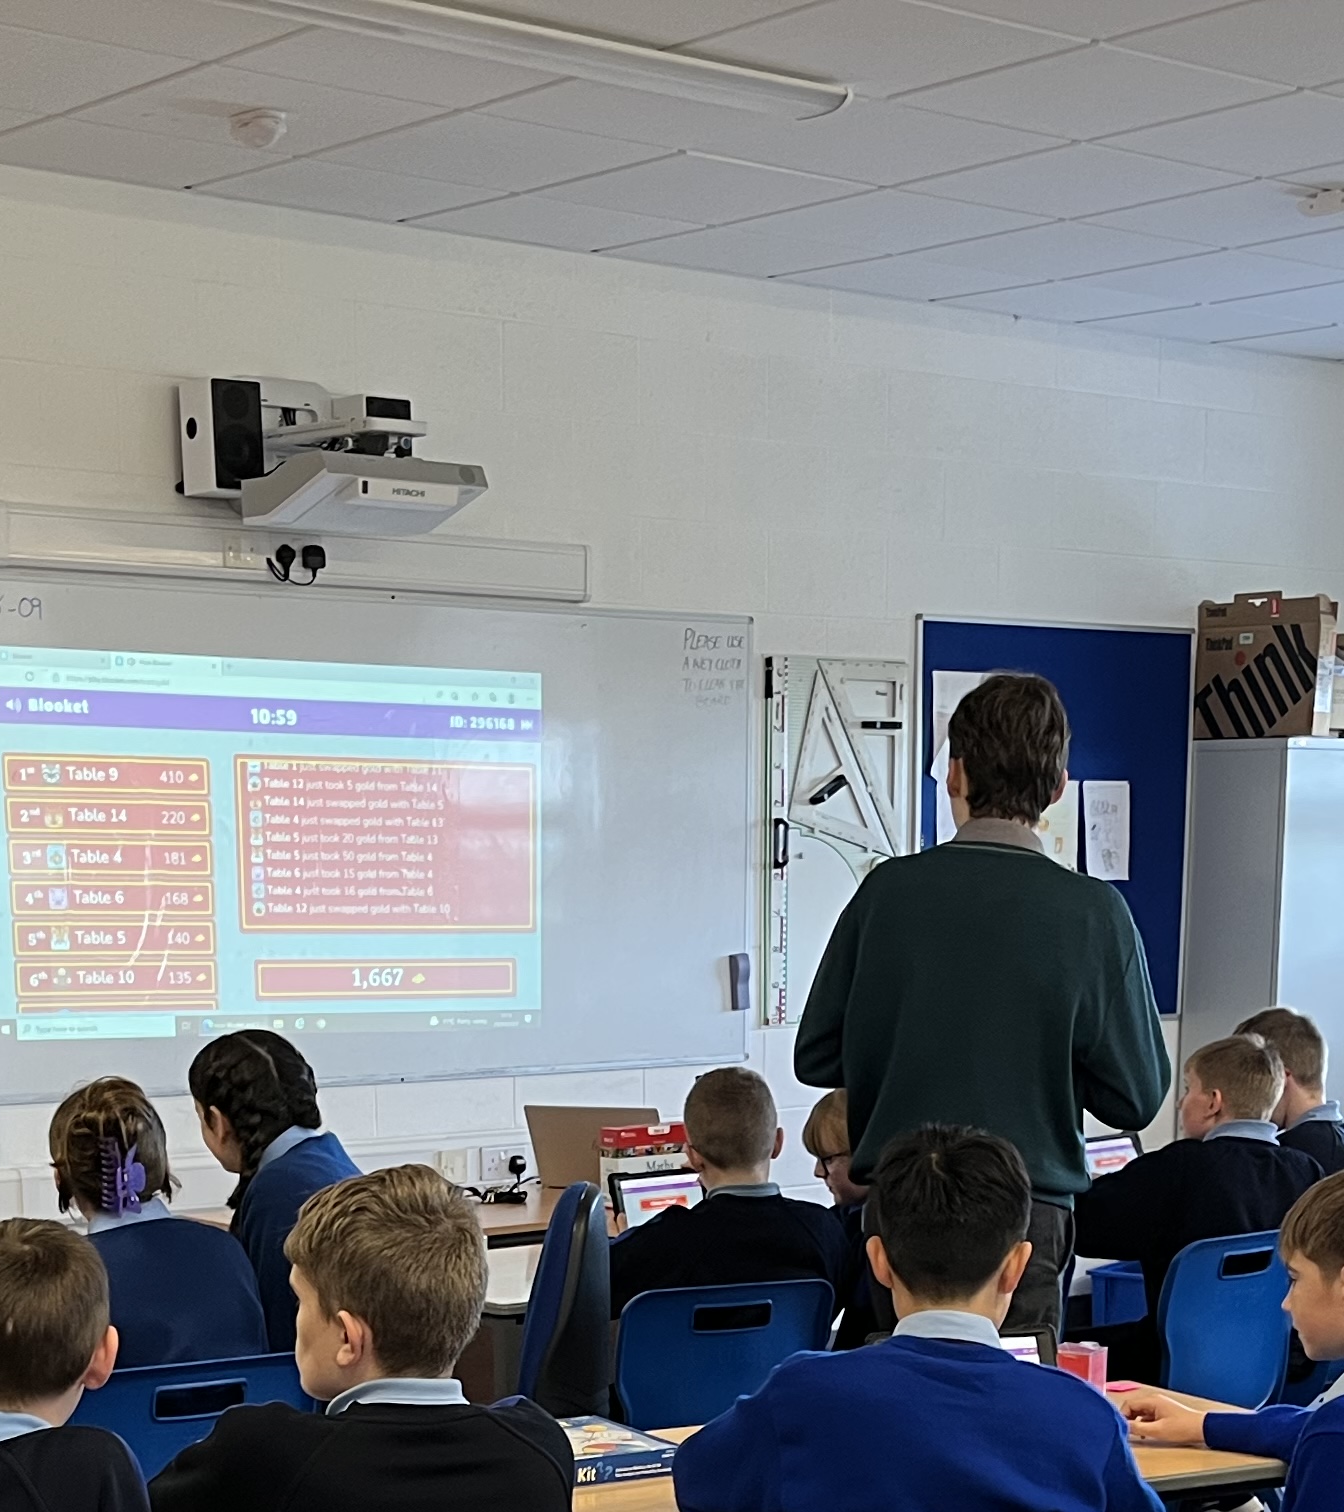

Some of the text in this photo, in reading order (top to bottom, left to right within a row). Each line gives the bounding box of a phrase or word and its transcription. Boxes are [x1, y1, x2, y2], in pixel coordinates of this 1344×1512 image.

[392, 488, 426, 497] HITACHI
[683, 627, 723, 651] PLEASE
[1194, 624, 1318, 738] Think
[27, 698, 89, 714] Blooket
[250, 708, 297, 726] 10:59
[449, 715, 468, 729] ID:
[65, 766, 106, 782] Table
[108, 767, 119, 782] 9
[159, 770, 184, 784] 410
[263, 777, 290, 789] Table
[292, 779, 304, 789] 12
[306, 780, 323, 791] just
[325, 780, 344, 790] took
[355, 781, 375, 792] gold
[377, 782, 398, 791] from
[400, 782, 424, 793] Table
[426, 782, 438, 793] 14
[263, 795, 290, 807] Table
[293, 797, 305, 807] 14
[306, 798, 324, 809] just
[325, 798, 366, 810] swapped
[368, 799, 388, 810] gold
[390, 799, 410, 809] with
[411, 799, 436, 810] Table
[19, 807, 186, 824] 2nd Table 14 220
[266, 833, 291, 843] Table
[301, 834, 318, 845] just
[320, 834, 340, 843] took
[342, 833, 354, 844] 20
[356, 834, 376, 846] gold
[377, 834, 398, 844] from
[401, 834, 424, 845] Table
[427, 835, 438, 845] 13
[22, 849, 186, 865] 3rd Table 4 181
[73, 889, 111, 905] Table
[114, 890, 125, 904] 6
[165, 892, 189, 905] 168
[75, 930, 113, 944] Table
[116, 931, 126, 944] 5
[167, 931, 190, 945] 140
[29, 970, 192, 987] 6th Table 10 135
[351, 968, 404, 989] 1,667
[577, 1466, 596, 1483] Kit
